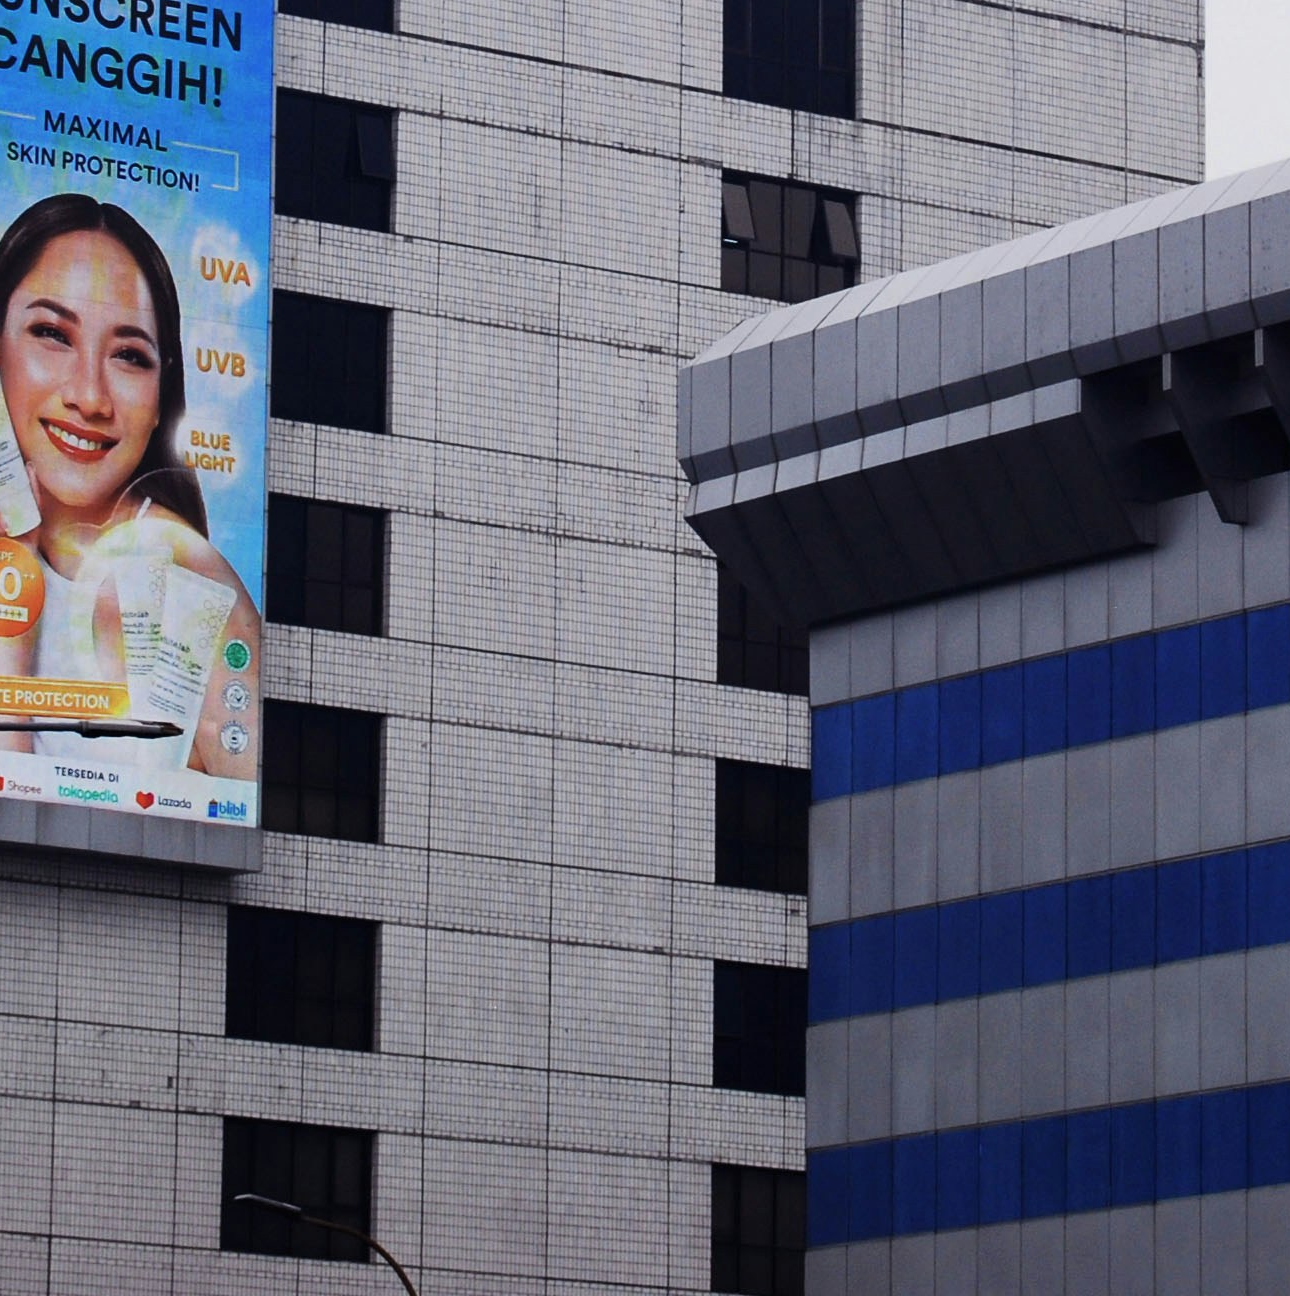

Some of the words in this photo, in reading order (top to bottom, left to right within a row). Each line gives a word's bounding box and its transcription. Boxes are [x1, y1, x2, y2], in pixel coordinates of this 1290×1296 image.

[43, 109, 168, 152] MAXIMAL
[7, 142, 56, 168] SKIN
[62, 152, 200, 192] PROTECTION!
[200, 256, 250, 286] UVA
[196, 347, 245, 377] UVB
[190, 430, 231, 451] BLUE
[185, 451, 236, 473] LIGHT
[15, 690, 109, 708] PROTECTION
[54, 767, 104, 781] TERSEDIA
[108, 773, 119, 783] DI
[8, 780, 42, 795] Shopee
[59, 785, 119, 803] tokopedia
[158, 795, 192, 809] Lazada
[219, 800, 247, 817] blibli
